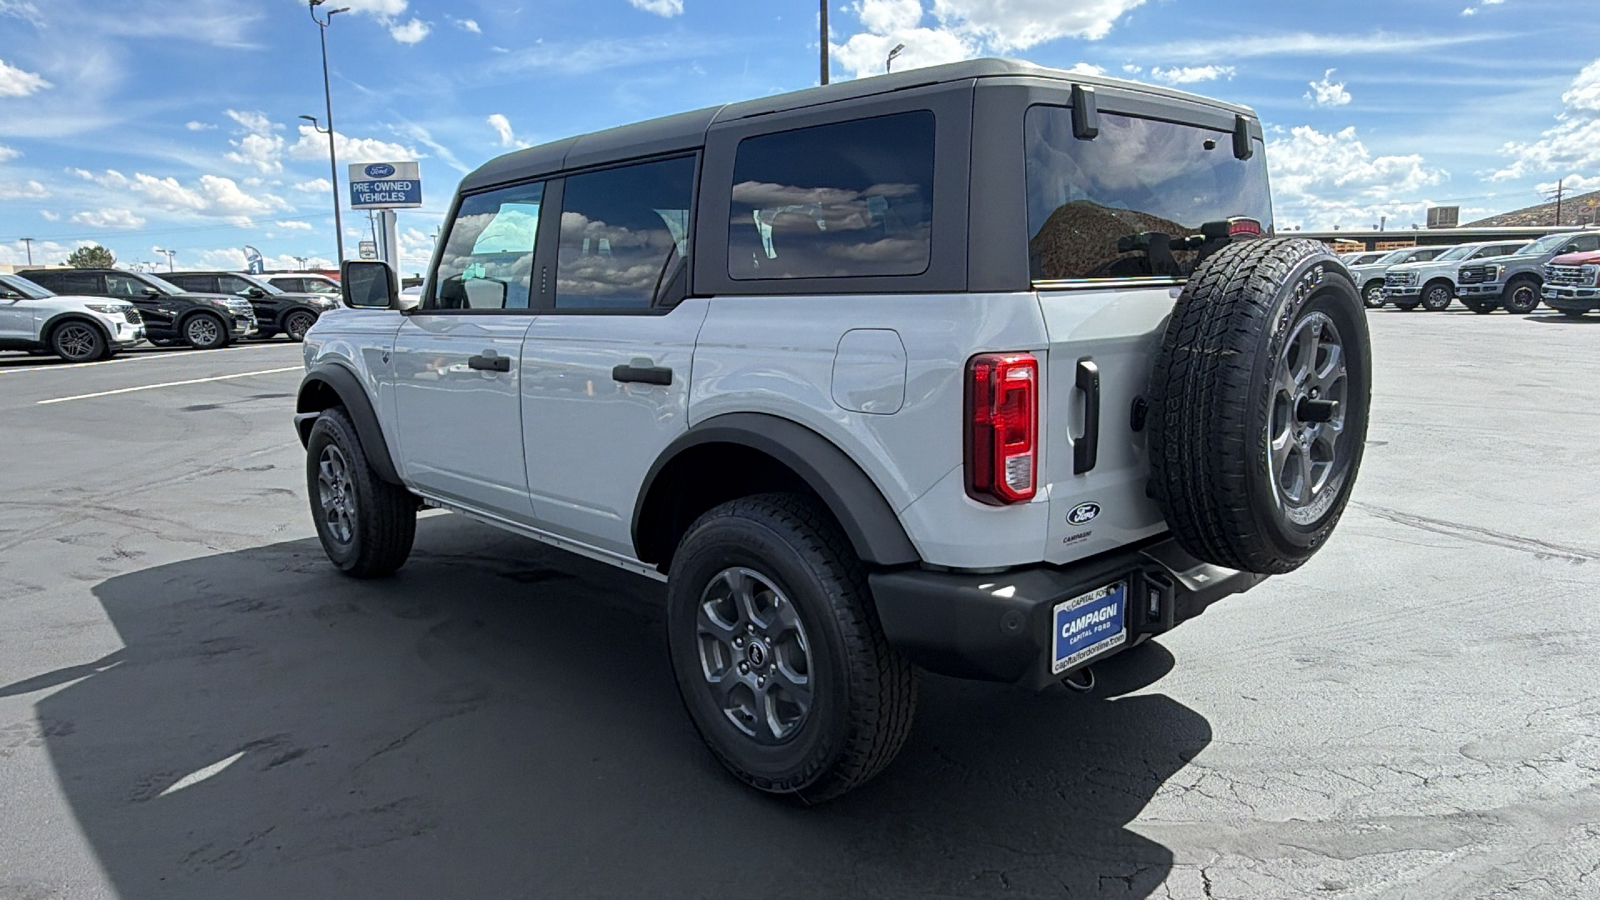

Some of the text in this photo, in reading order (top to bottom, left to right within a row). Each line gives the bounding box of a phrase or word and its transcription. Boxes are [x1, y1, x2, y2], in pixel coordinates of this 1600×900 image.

[370, 166, 388, 176] Ford
[359, 192, 406, 203] VEHICLES
[1074, 505, 1096, 523] Ford
[1071, 593, 1094, 609] CAPITAL
[1062, 602, 1117, 639] CAMPAGNI
[1069, 621, 1111, 645] CAPITAL FORD
[1055, 633, 1124, 671] capitalfordonline.com
